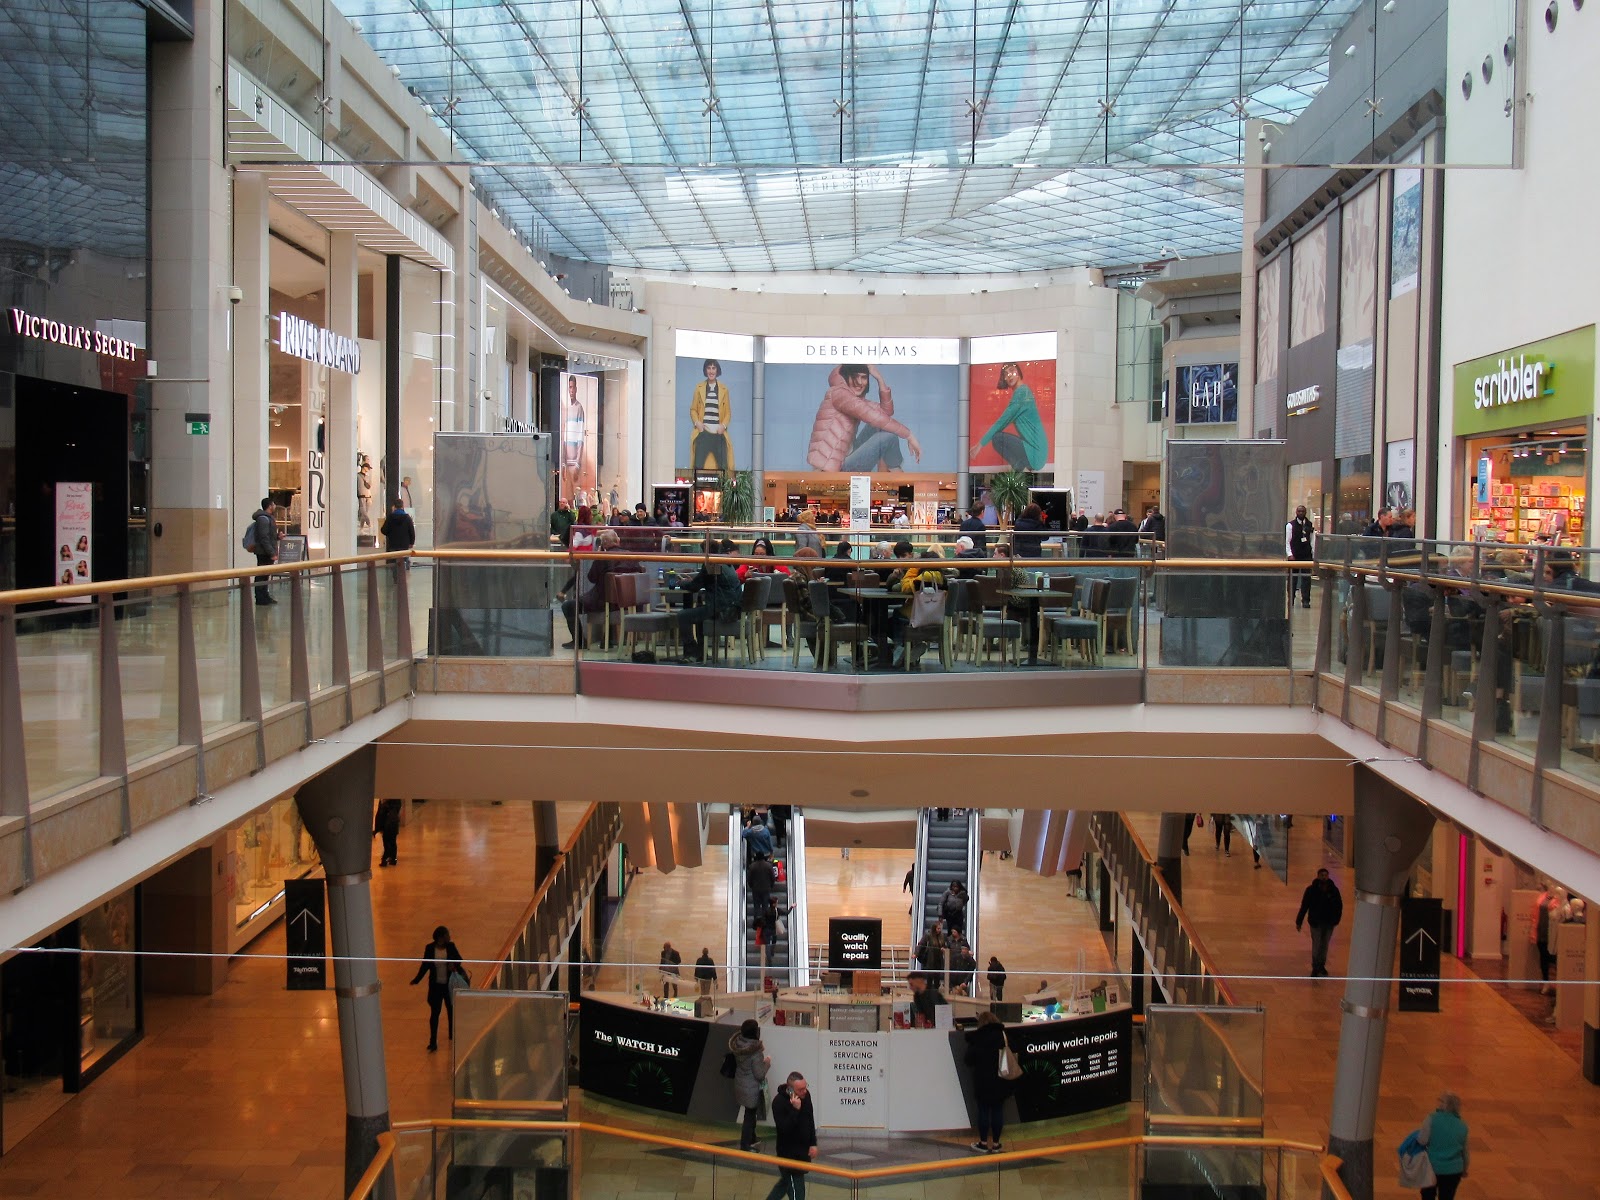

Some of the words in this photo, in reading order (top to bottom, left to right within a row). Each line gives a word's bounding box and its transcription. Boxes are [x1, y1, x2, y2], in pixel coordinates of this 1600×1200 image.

[12, 308, 91, 351] VICTORIA'S
[95, 330, 137, 362] SECRET
[281, 311, 320, 363] RIVER
[320, 328, 361, 375] ISLAND
[806, 345, 918, 357] DEBENHAMS
[1474, 354, 1543, 410] scribbler
[1192, 381, 1222, 408] GAP
[841, 933, 869, 942] Quality
[842, 952, 869, 960] repairs
[594, 1030, 612, 1043] The
[616, 1035, 656, 1053] WATCH
[1026, 1040, 1061, 1053] Quality
[1062, 1035, 1089, 1048] watch
[1091, 1030, 1118, 1043] repairs
